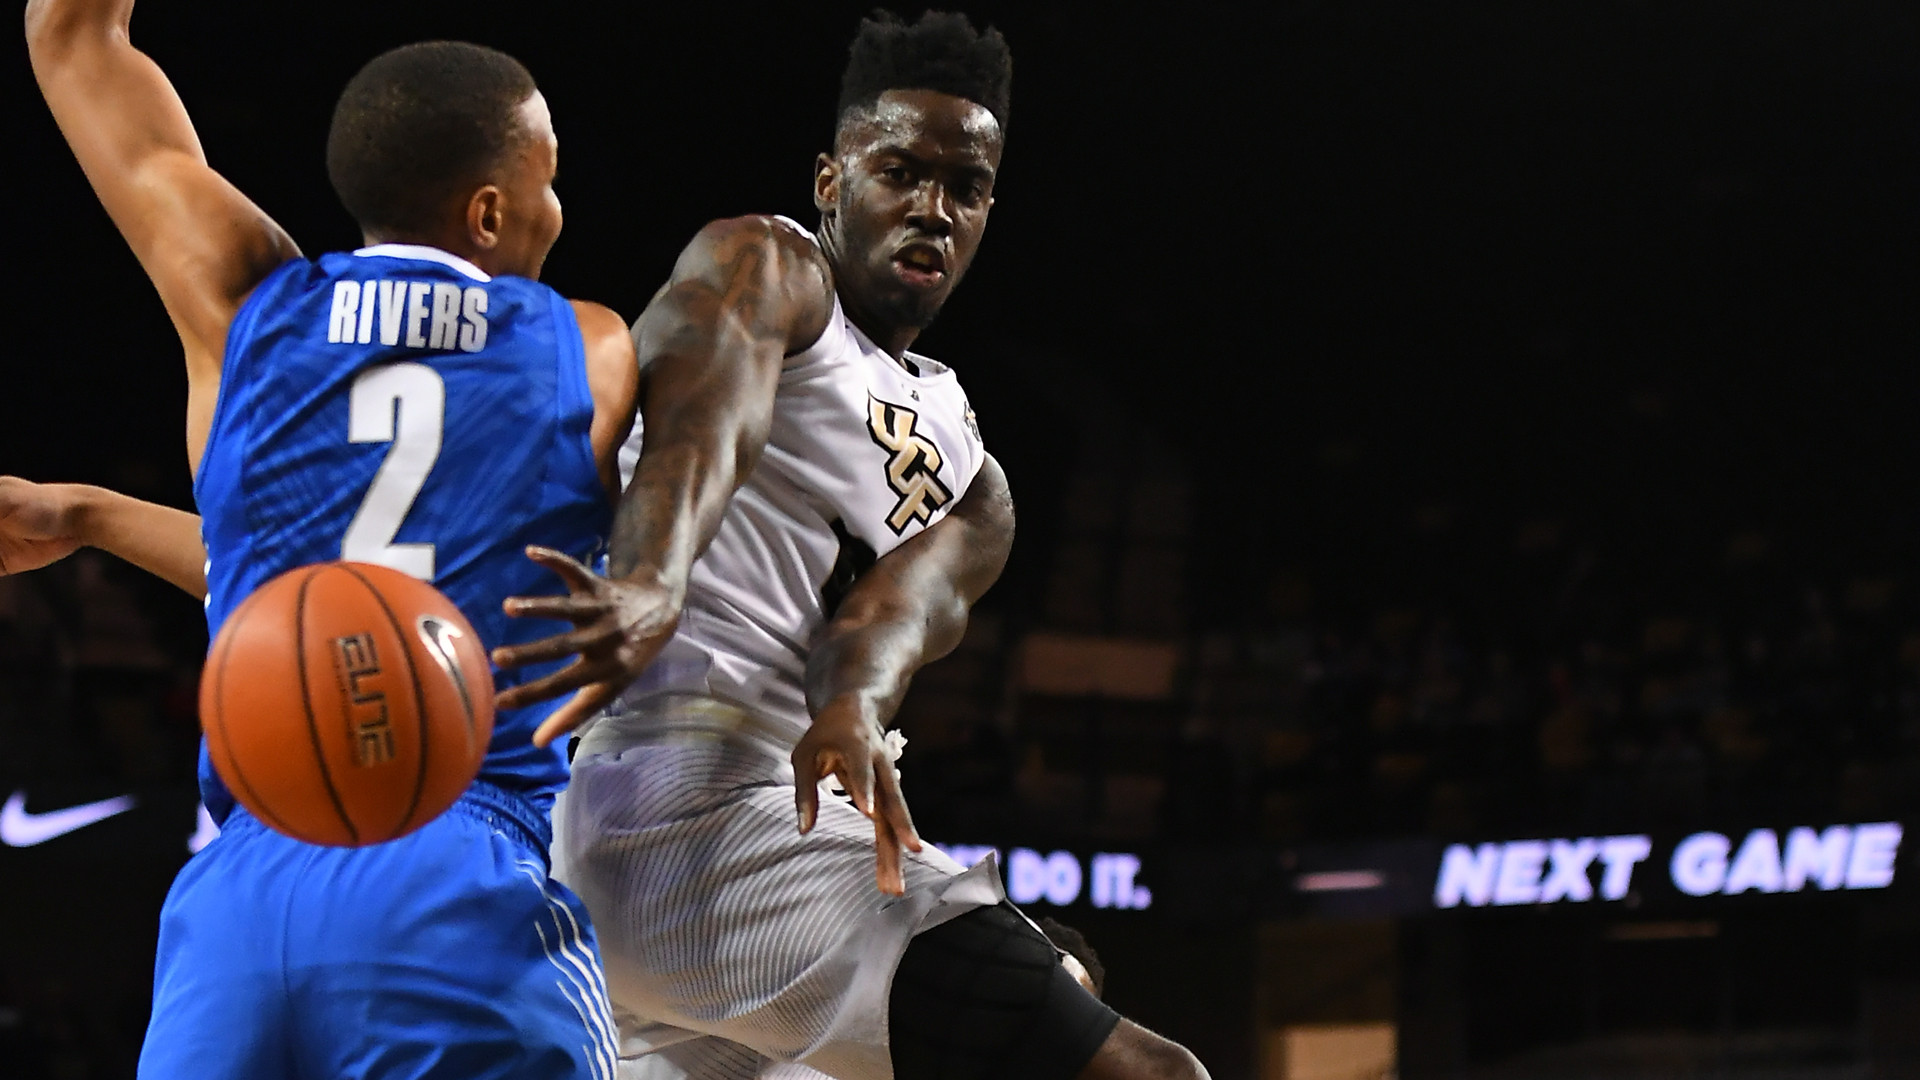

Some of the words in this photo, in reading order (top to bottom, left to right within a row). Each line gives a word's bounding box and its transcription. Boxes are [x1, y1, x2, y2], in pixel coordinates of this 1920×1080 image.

[327, 279, 489, 353] RIVERS
[340, 361, 446, 582] 2
[867, 386, 954, 536] UCF
[336, 632, 395, 768] ELITE
[1007, 846, 1083, 907] DO
[1090, 851, 1153, 911] IT.
[1433, 833, 1652, 909] NEXT
[1669, 821, 1904, 897] GAME
